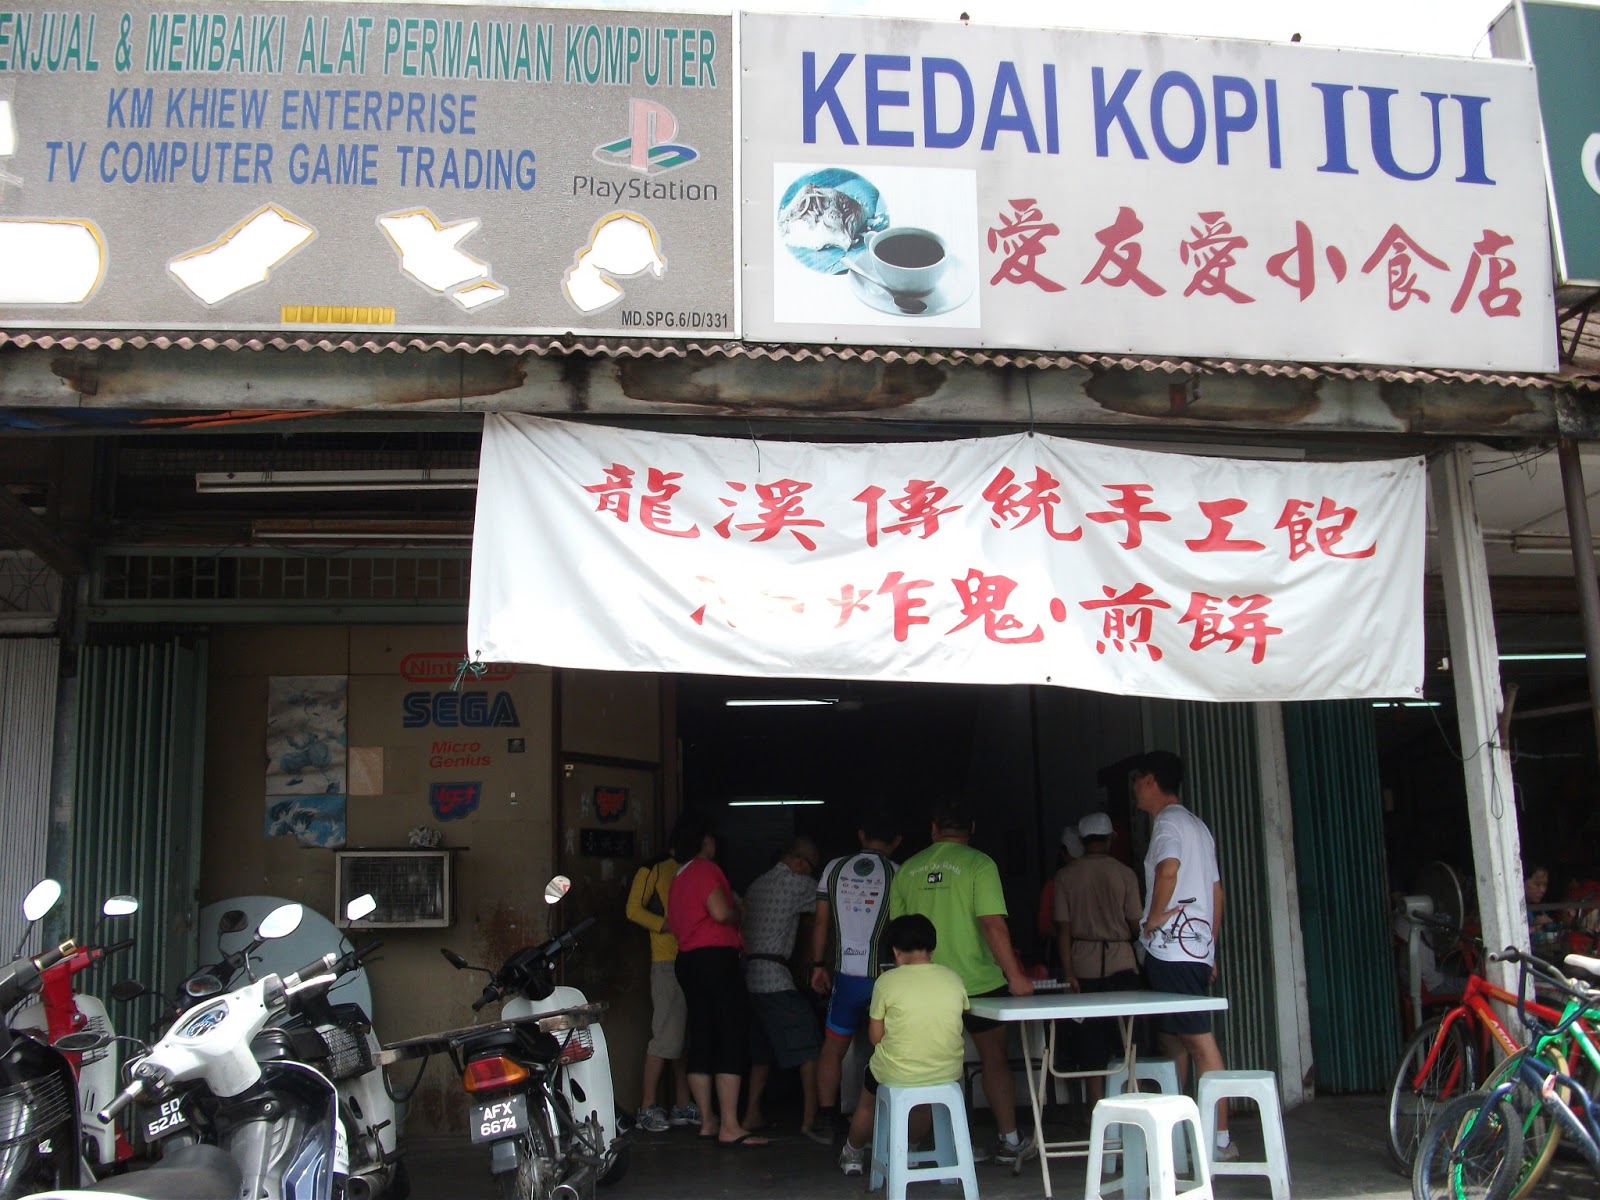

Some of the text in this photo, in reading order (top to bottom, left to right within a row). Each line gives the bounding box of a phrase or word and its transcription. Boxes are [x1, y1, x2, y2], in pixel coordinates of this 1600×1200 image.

[115, 13, 132, 72] &
[146, 13, 286, 73] MEMBAIKI
[297, 16, 374, 75] ALAT
[384, 17, 552, 82] PERMAINAN
[565, 24, 716, 87] KOMPUTER
[107, 87, 478, 135] KM KHIEW ENTERPRISE
[802, 51, 1060, 155] KEDAI
[1091, 66, 1282, 170] KOPI
[1311, 82, 1497, 186] IUI
[46, 141, 537, 191] TV COMPUTER GAME TRADING
[572, 175, 718, 205] PlayStation
[986, 197, 1523, 318] 愛友愛小食店
[621, 310, 729, 329] MD.SPG.6/D/331
[581, 462, 1378, 563] 龍溪傳統手工飽
[410, 660, 507, 676] Ninto
[402, 691, 521, 728] SEGA
[429, 754, 492, 769] Genius
[431, 740, 481, 755] Micro
[480, 1116, 517, 1136] 6674
[483, 1101, 513, 1121] AFX
